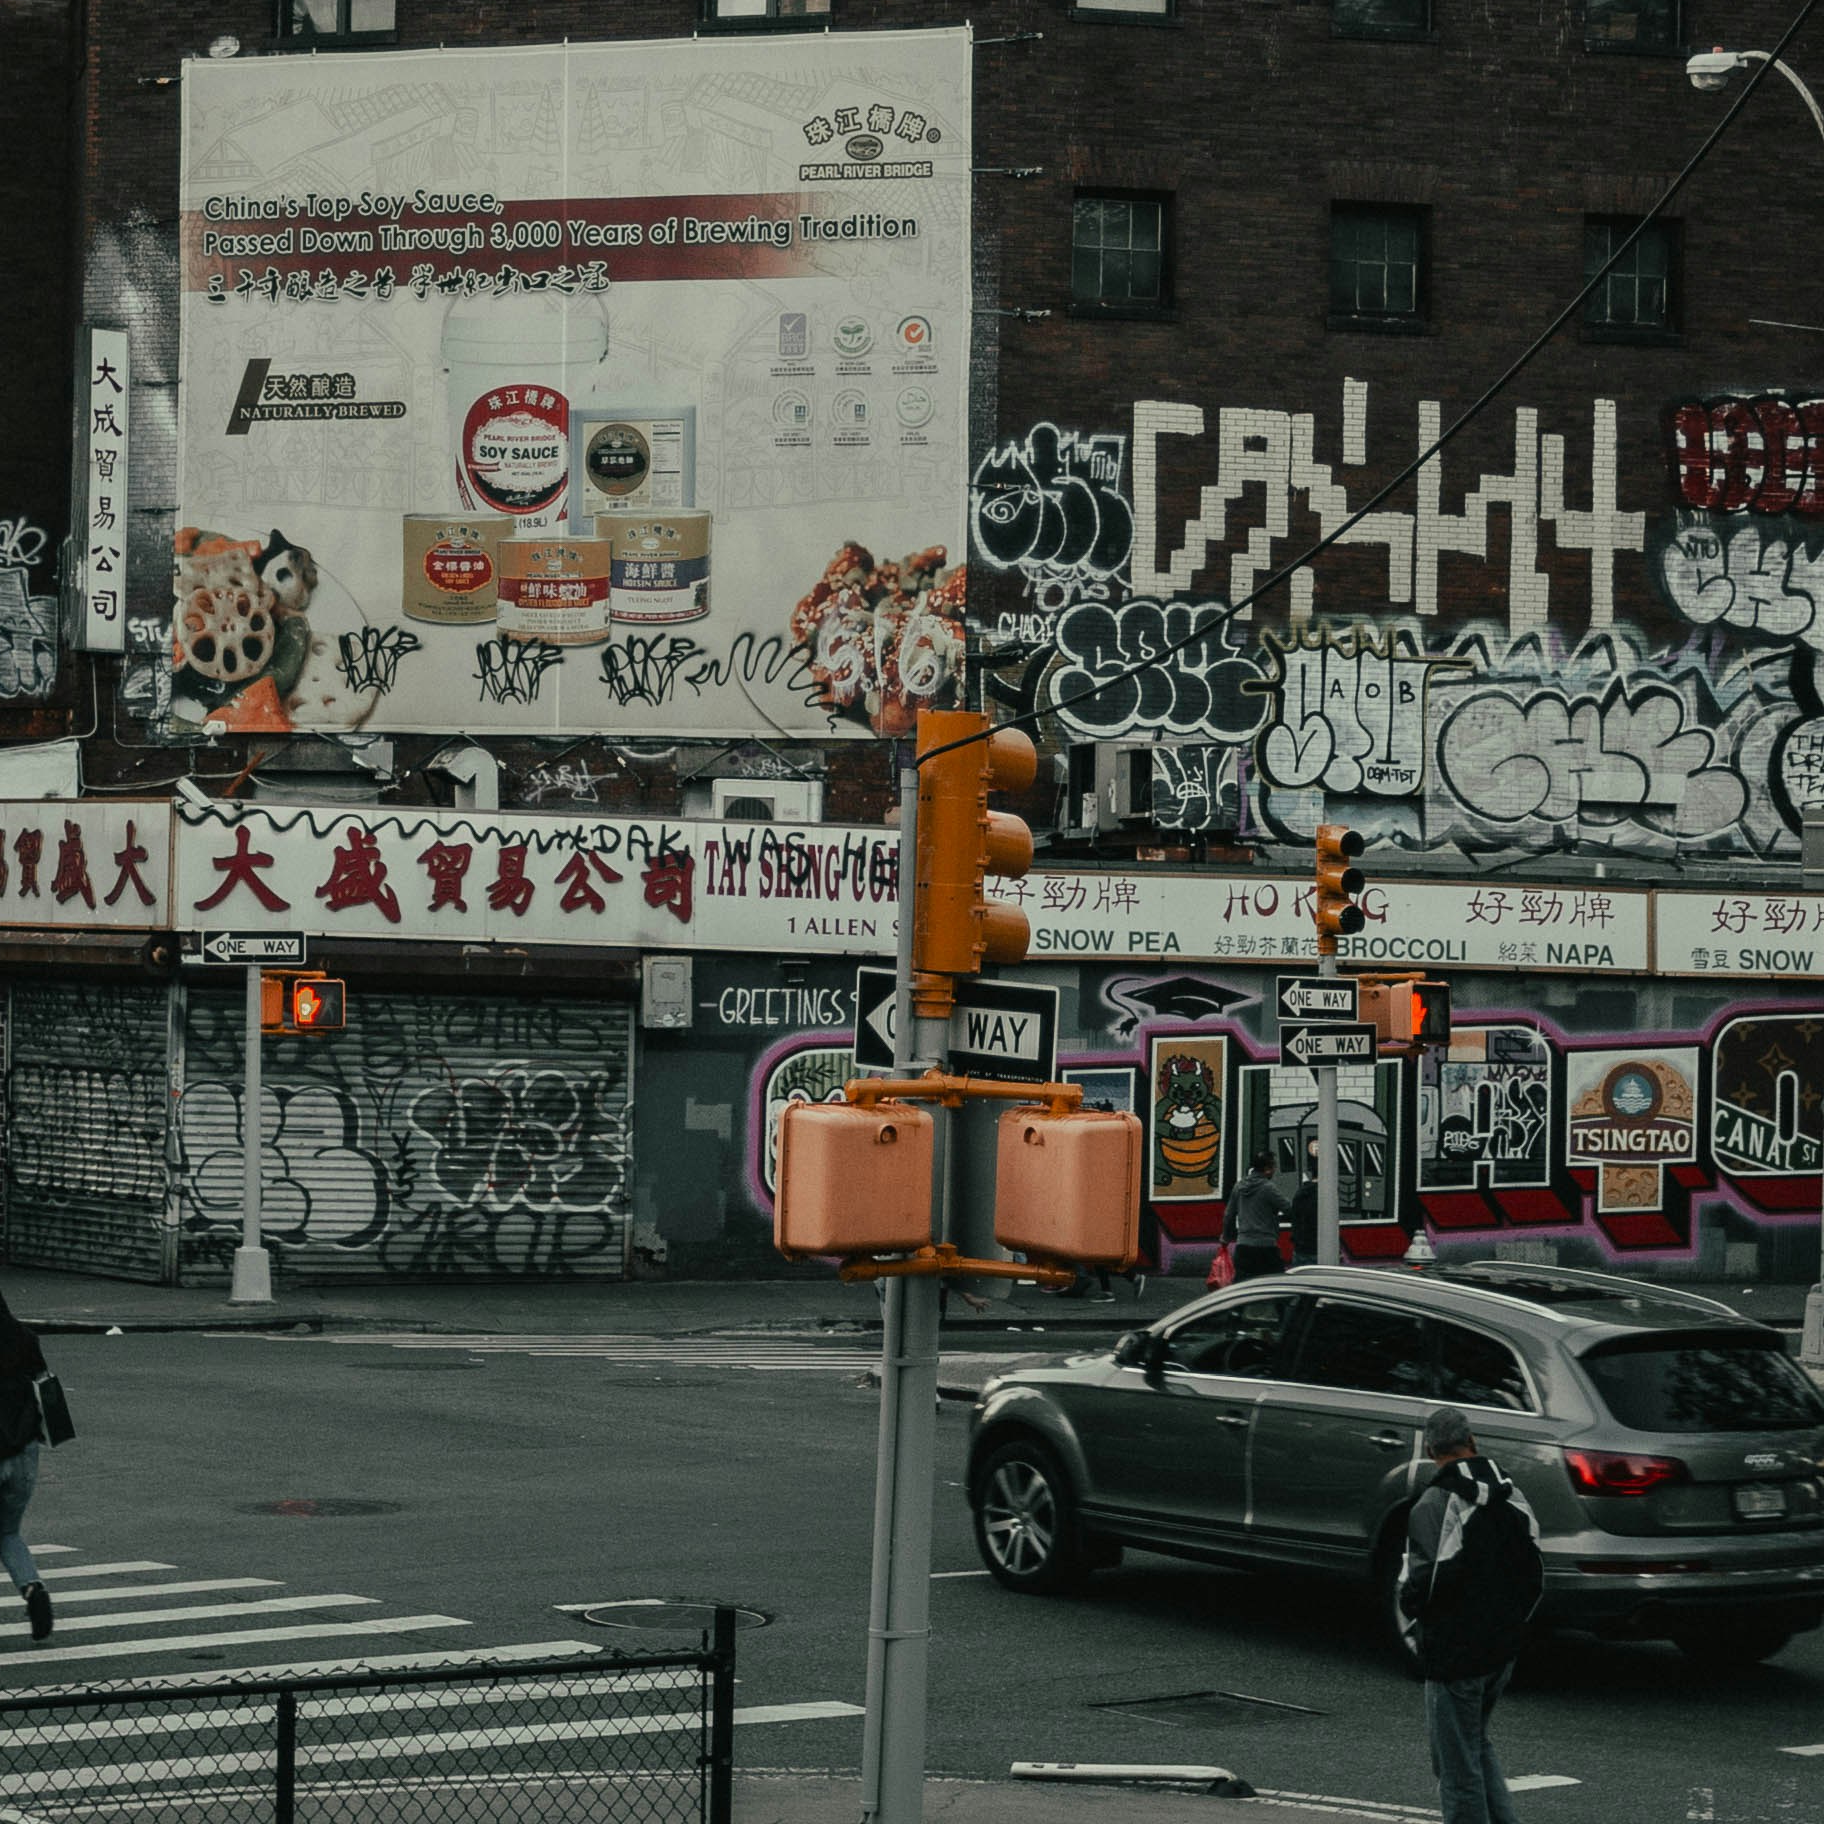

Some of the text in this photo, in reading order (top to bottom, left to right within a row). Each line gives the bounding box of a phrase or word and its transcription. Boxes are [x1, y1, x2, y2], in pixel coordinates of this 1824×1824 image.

[800, 161, 933, 180] PEARL RIVER BRIDGE
[205, 189, 504, 221] China's Top Soy Sauce,
[204, 214, 919, 256] Passed Down Through 3,000 Years of Brewing Tradition
[239, 401, 405, 421] NATURALLY BREWED
[483, 434, 507, 442] PEARL
[479, 445, 559, 459] SOY SAUCE
[704, 840, 842, 902] TAY SHING
[1223, 883, 1279, 923] HO
[1294, 885, 1389, 924] KG
[1466, 889, 1615, 928] 好勁牌
[787, 916, 877, 937] 1 ALLEN
[216, 940, 295, 954] ONE WAY
[1036, 928, 1114, 950] SNOW
[1129, 931, 1181, 952] PEA
[1335, 937, 1466, 961] BROCCOLI
[1546, 944, 1615, 965] NAPA
[1739, 949, 1814, 972] SNOW
[719, 987, 846, 1025] GREETINGS
[1289, 990, 1347, 1008] ONE WAY
[967, 1012, 1028, 1053] WAY
[1295, 1037, 1364, 1054] ONE WAY
[1573, 1127, 1691, 1153] TSINGTAO
[1715, 1108, 1817, 1171] CANAL ST
